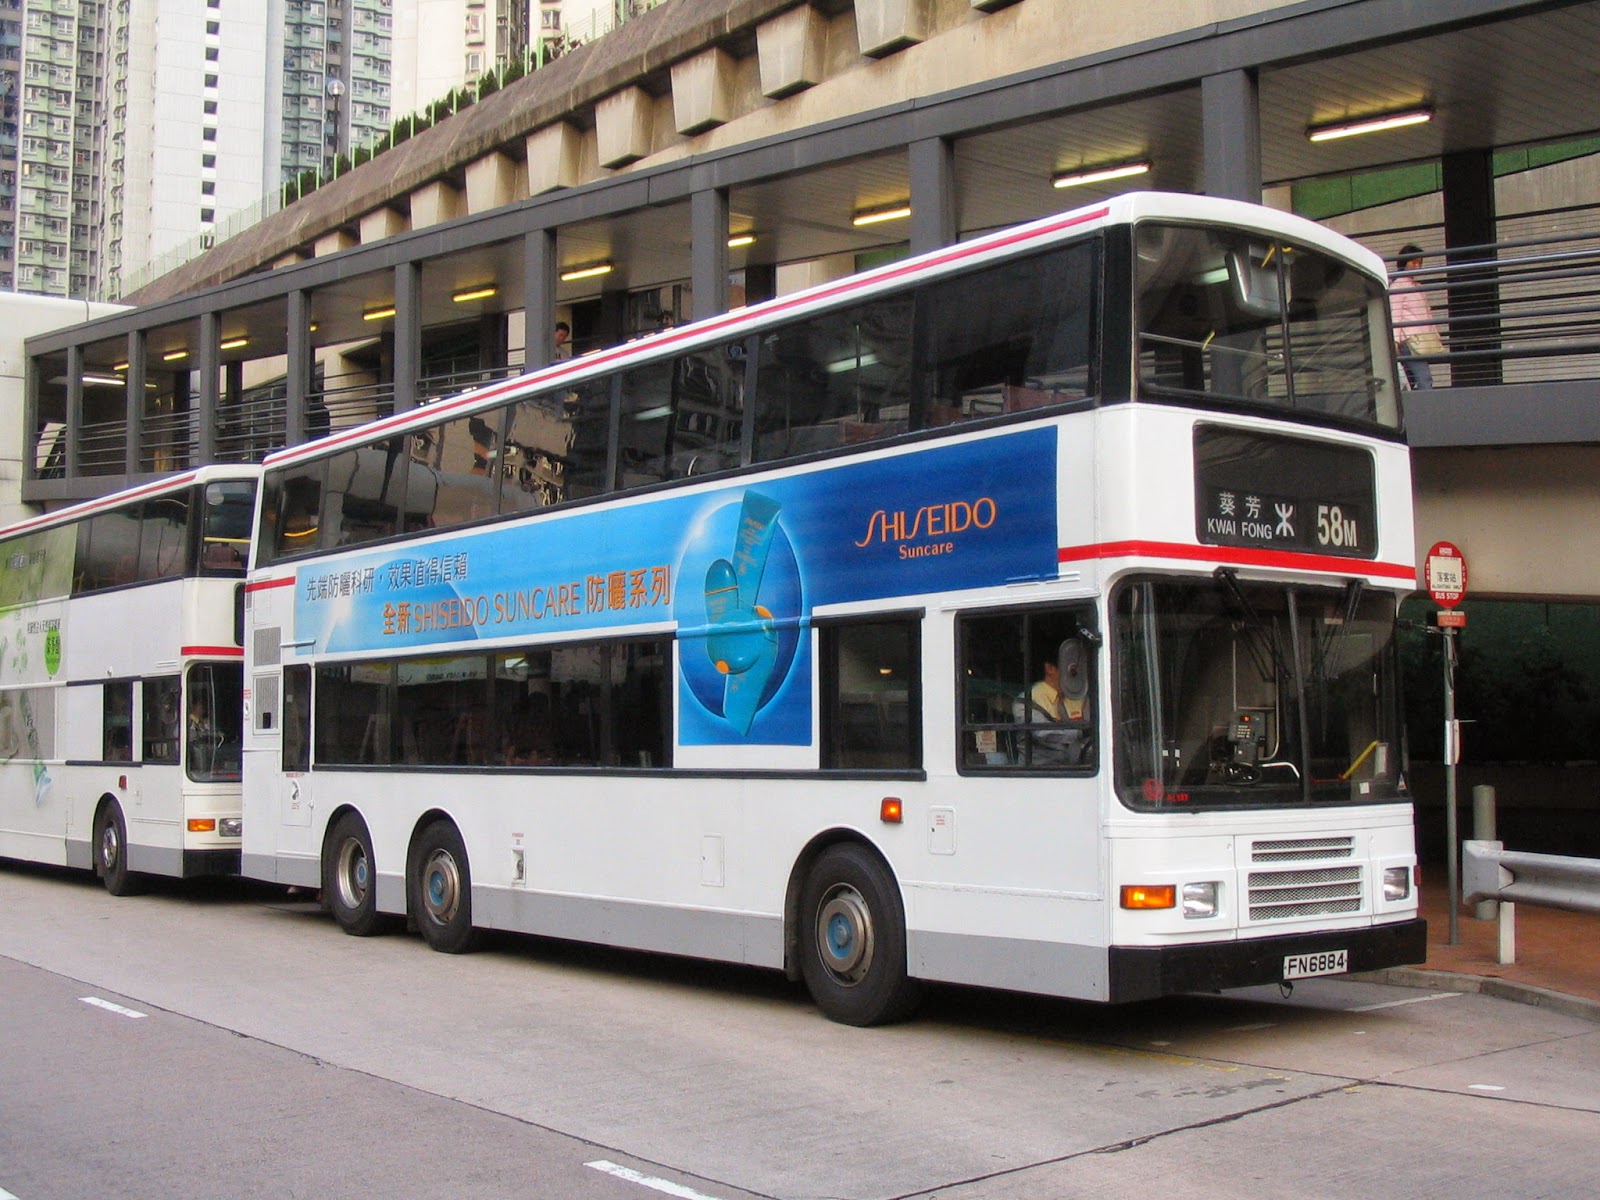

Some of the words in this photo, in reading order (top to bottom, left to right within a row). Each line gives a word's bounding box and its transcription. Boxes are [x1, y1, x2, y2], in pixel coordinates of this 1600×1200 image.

[1219, 492, 1262, 519] 葵芳
[855, 497, 997, 547] SHISEIDO
[1207, 518, 1236, 535] KWAI
[1241, 522, 1273, 540] FONG
[1317, 505, 1358, 547] 58M
[899, 542, 954, 560] Suncare
[382, 603, 411, 635] 全新
[414, 596, 490, 633] SHISEIDO
[494, 581, 581, 624] SUNCARE
[585, 564, 671, 613] 防曬系列
[1435, 592, 1446, 600] BUS
[1446, 592, 1460, 600] STOP
[1287, 952, 1345, 976] FN6884
